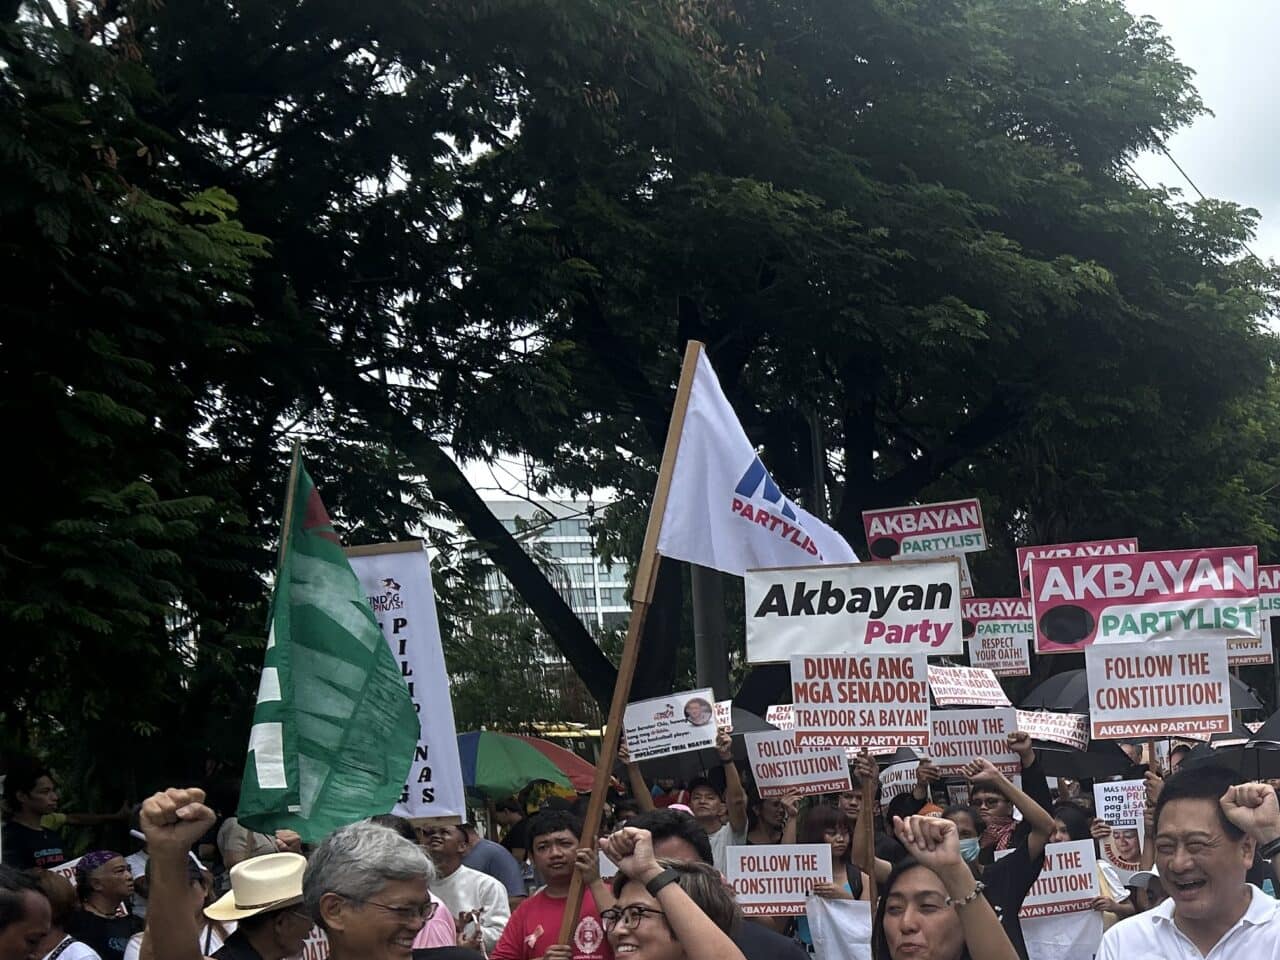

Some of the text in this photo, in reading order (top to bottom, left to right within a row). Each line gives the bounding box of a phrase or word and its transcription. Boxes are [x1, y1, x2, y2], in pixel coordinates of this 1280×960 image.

[731, 497, 824, 561] PARTYLIS
[869, 506, 979, 537] AKBAYAN
[903, 534, 983, 553] PARTYLIST
[1039, 555, 1256, 601] AKBAYAN
[754, 580, 953, 619] Akbayan
[978, 623, 1034, 634] PARTYLIS
[1103, 604, 1259, 636] PARTYLIST
[863, 619, 954, 647] Party
[981, 637, 1014, 649] RESPECT
[975, 648, 1023, 661] YOUR OATH!
[804, 656, 913, 681] DUWAG ANG
[1104, 652, 1210, 680] FOLLOW THE
[794, 680, 927, 704] MGA SENADOR!
[1096, 681, 1223, 711] CONSTITUTION!
[796, 709, 928, 728] TRAYDOR SA BAYAN!
[932, 718, 1005, 737] FOLLOW THE
[1100, 720, 1224, 736] AKBAYAN PARTYLIST
[800, 734, 926, 746] AKBAYAN PARTYLIST
[928, 739, 1013, 758] CONSTITUTION
[756, 754, 843, 779] CONSTITUTION!
[800, 781, 846, 793] PARTYLIST
[1104, 794, 1124, 803] ang
[1104, 803, 1121, 812] pag
[1104, 811, 1121, 819] nag
[740, 854, 818, 873] FOLLOW THE
[1057, 851, 1082, 870] THE
[1028, 872, 1094, 897] TITUTION!
[741, 905, 780, 914] KBAYAN
[1018, 905, 1046, 918] AYAN
